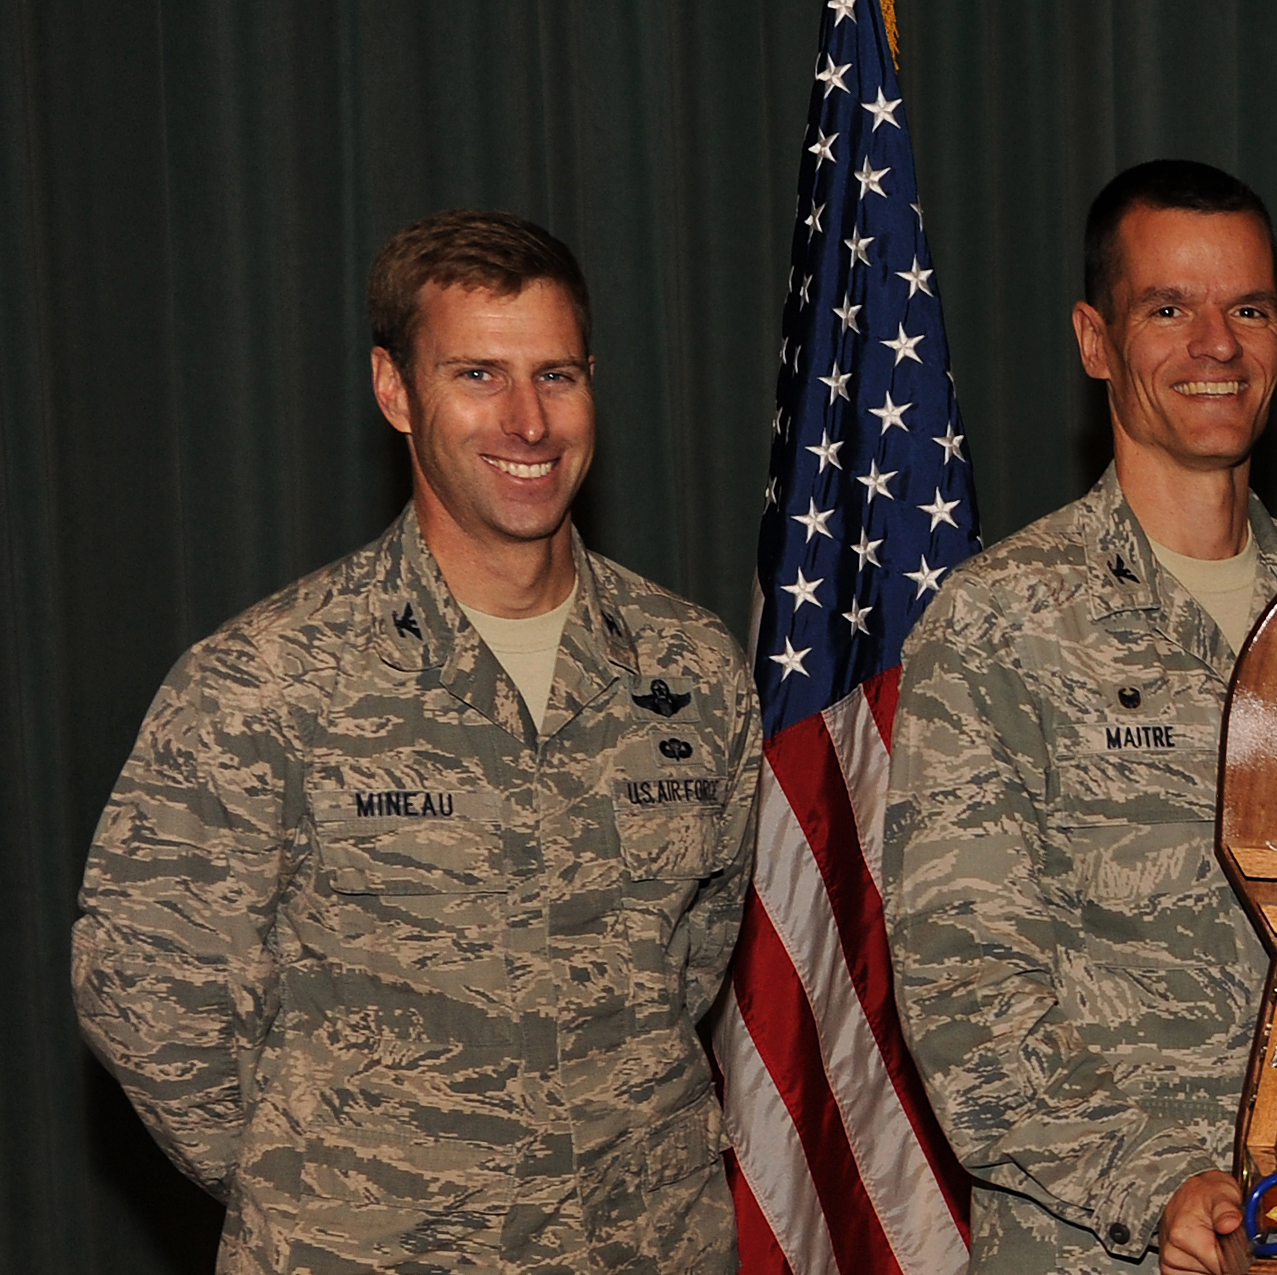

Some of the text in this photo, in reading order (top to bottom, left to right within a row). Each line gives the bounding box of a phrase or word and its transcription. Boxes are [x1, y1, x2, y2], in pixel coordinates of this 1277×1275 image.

[1106, 726, 1176, 749] MAITRE
[658, 779, 681, 802] AIR
[355, 791, 453, 817] MINEAU
